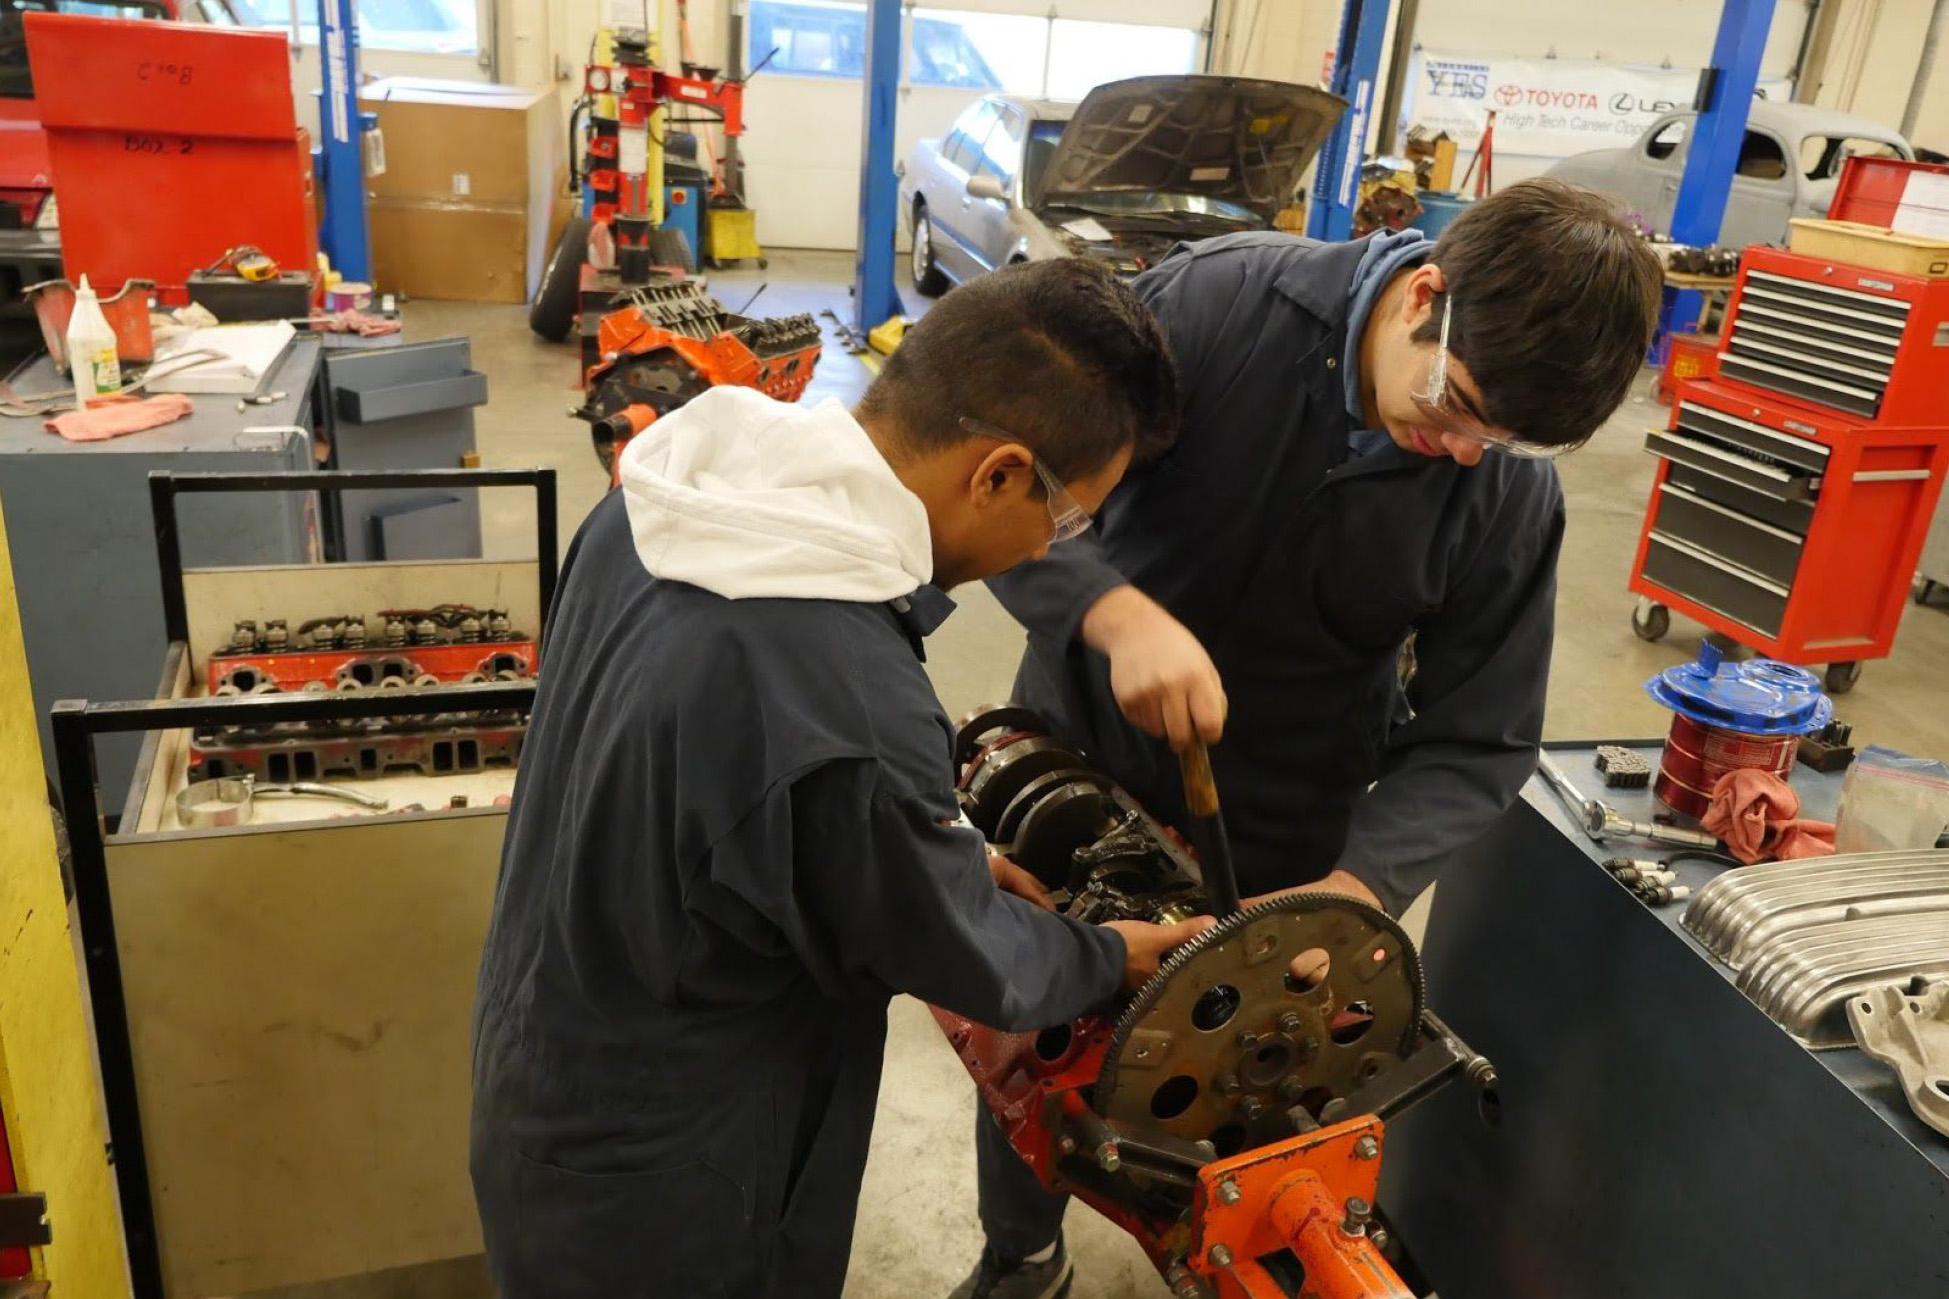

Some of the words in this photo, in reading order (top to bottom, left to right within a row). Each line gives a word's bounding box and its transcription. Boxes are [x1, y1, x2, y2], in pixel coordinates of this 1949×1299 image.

[1427, 70, 1487, 99] YES
[1527, 90, 1599, 110] TOYOTA
[1503, 111, 1535, 130] High
[1539, 114, 1567, 129] Tech
[1570, 115, 1612, 133] Career
[180, 137, 194, 155] 2
